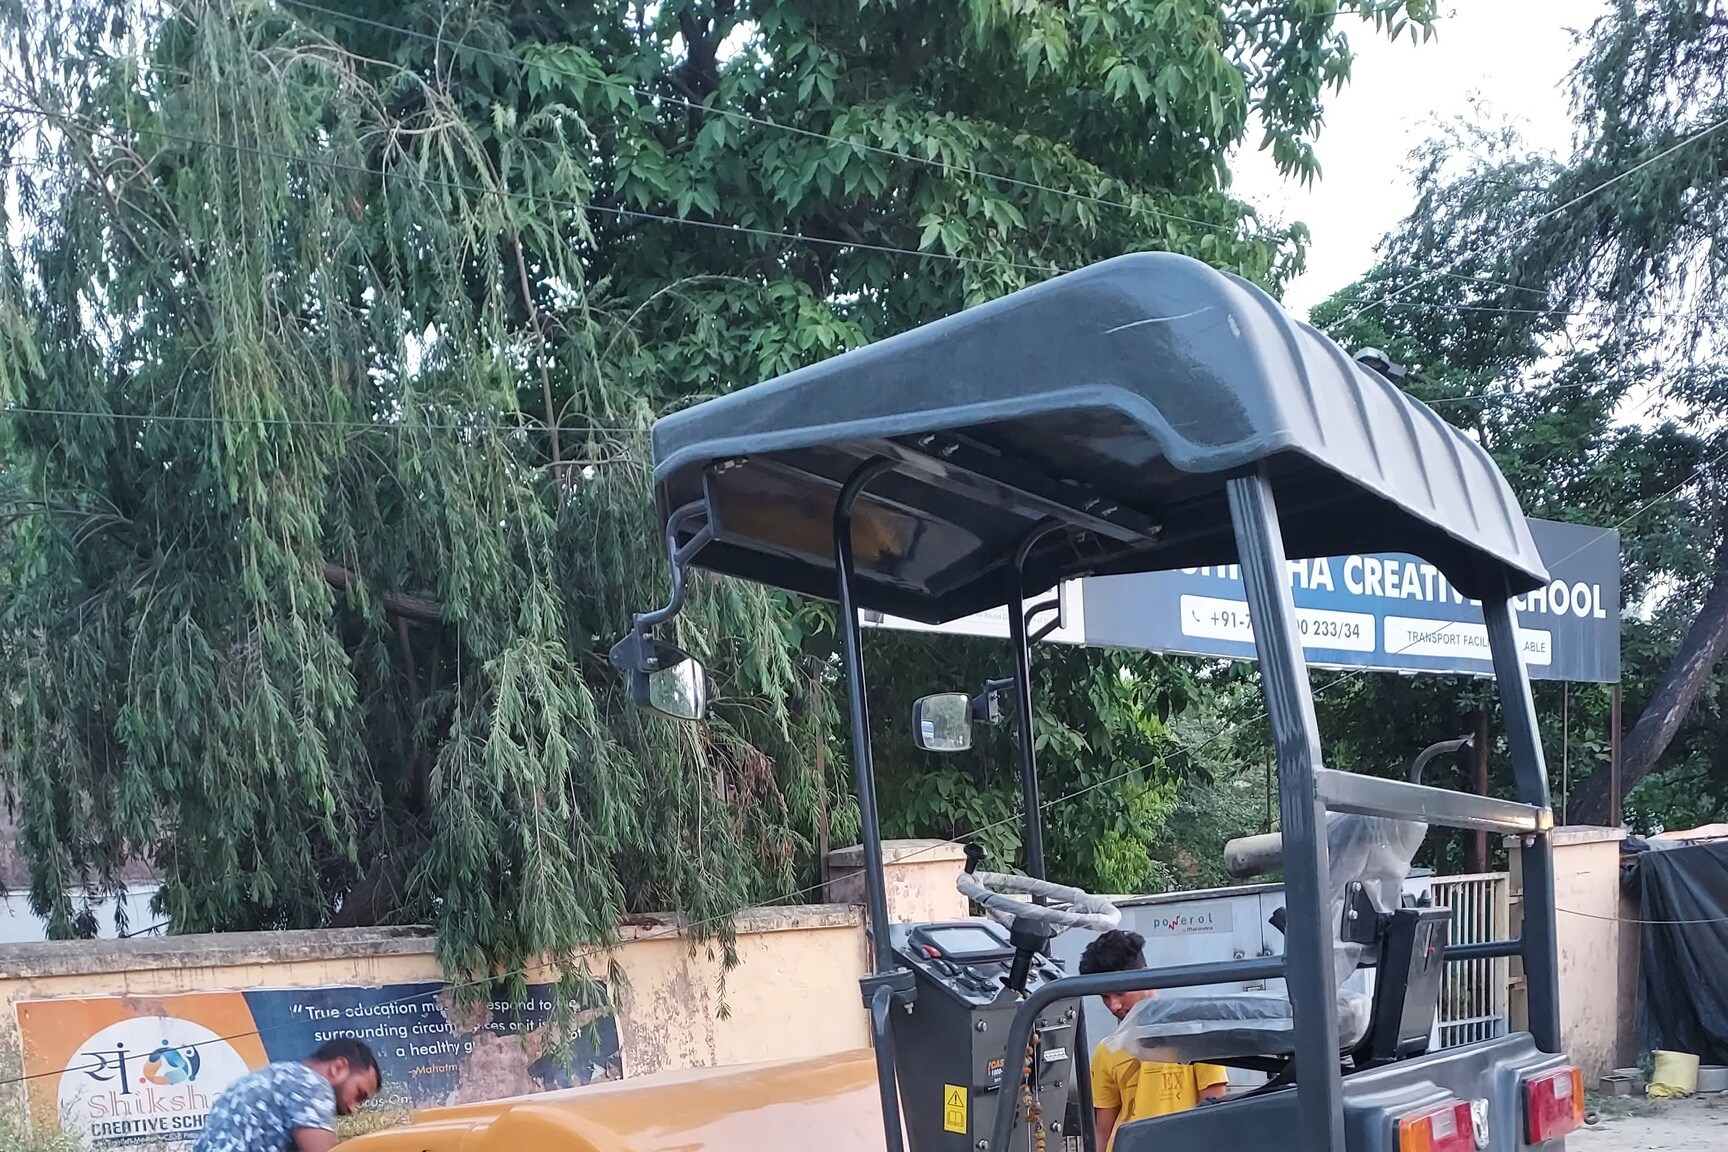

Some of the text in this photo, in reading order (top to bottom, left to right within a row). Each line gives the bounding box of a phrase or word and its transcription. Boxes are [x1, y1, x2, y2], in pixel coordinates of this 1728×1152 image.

[1313, 620, 1360, 639] 233/34
[1406, 630, 1461, 645] TRANSPORT
[1463, 634, 1490, 648] FACIL
[345, 1002, 418, 1018] education
[314, 1024, 408, 1042] surrounding
[395, 1047, 406, 1057] a
[409, 1040, 460, 1057] healthy
